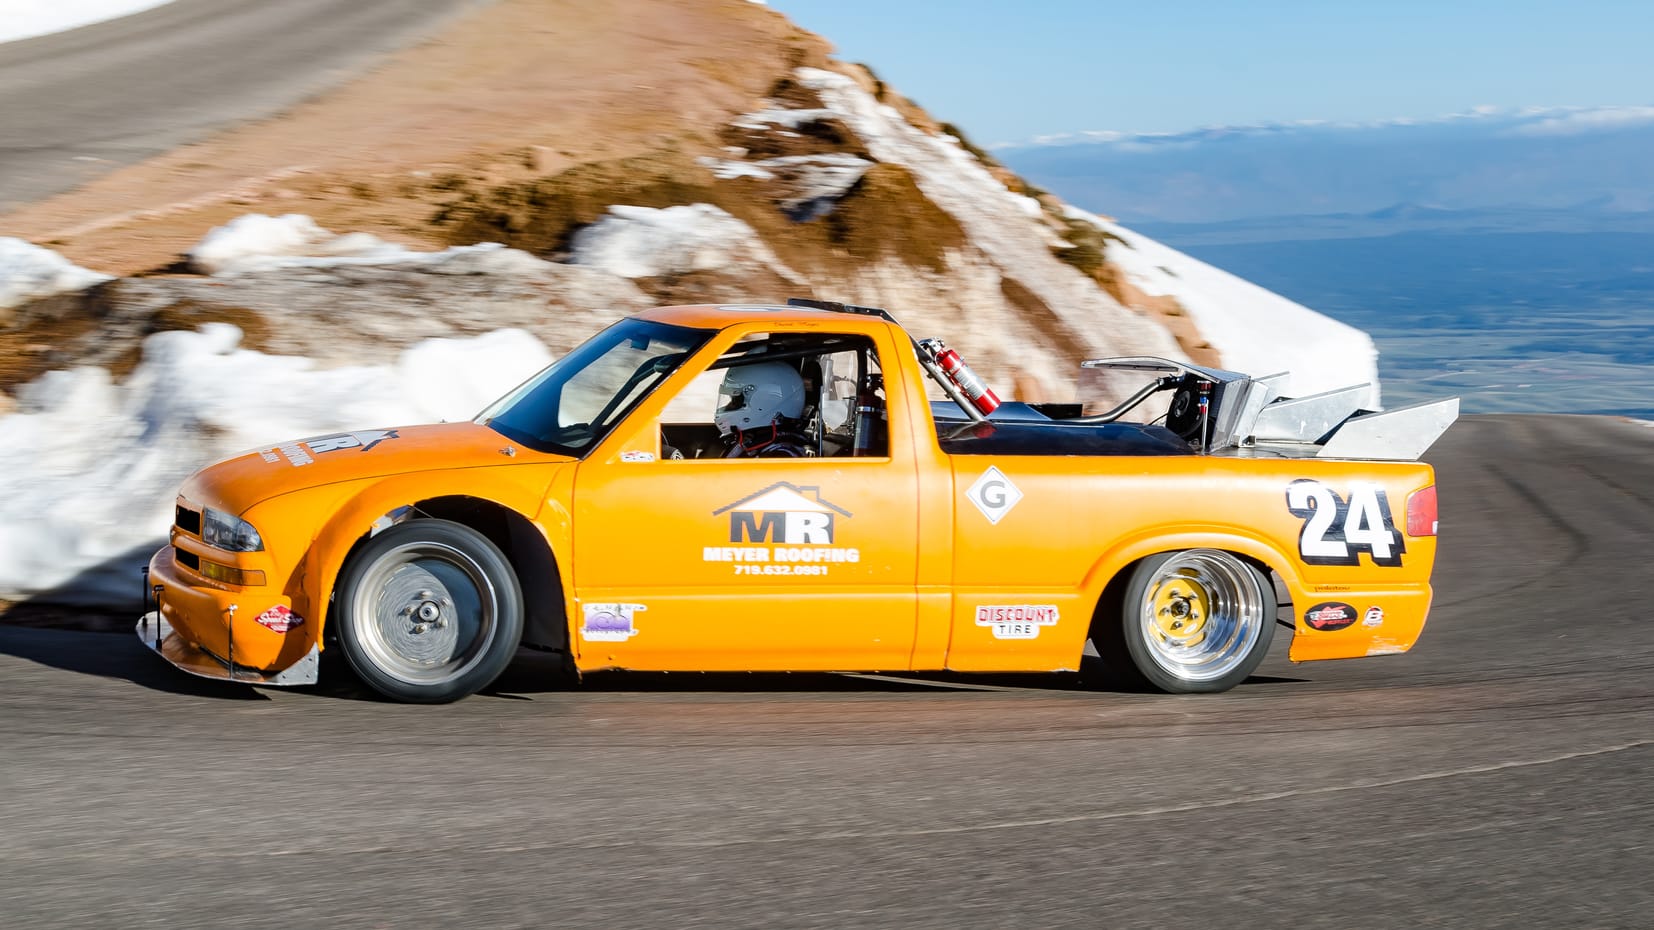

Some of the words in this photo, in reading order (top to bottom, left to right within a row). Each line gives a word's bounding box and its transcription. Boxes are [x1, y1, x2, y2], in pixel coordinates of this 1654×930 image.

[980, 480, 1006, 509] G
[730, 511, 834, 544] MR
[1286, 479, 1405, 567] 24
[703, 547, 770, 562] MEYER
[774, 547, 860, 563] ROOFING
[978, 608, 1054, 622] DISCOUNT
[999, 624, 1031, 634] TIRE
